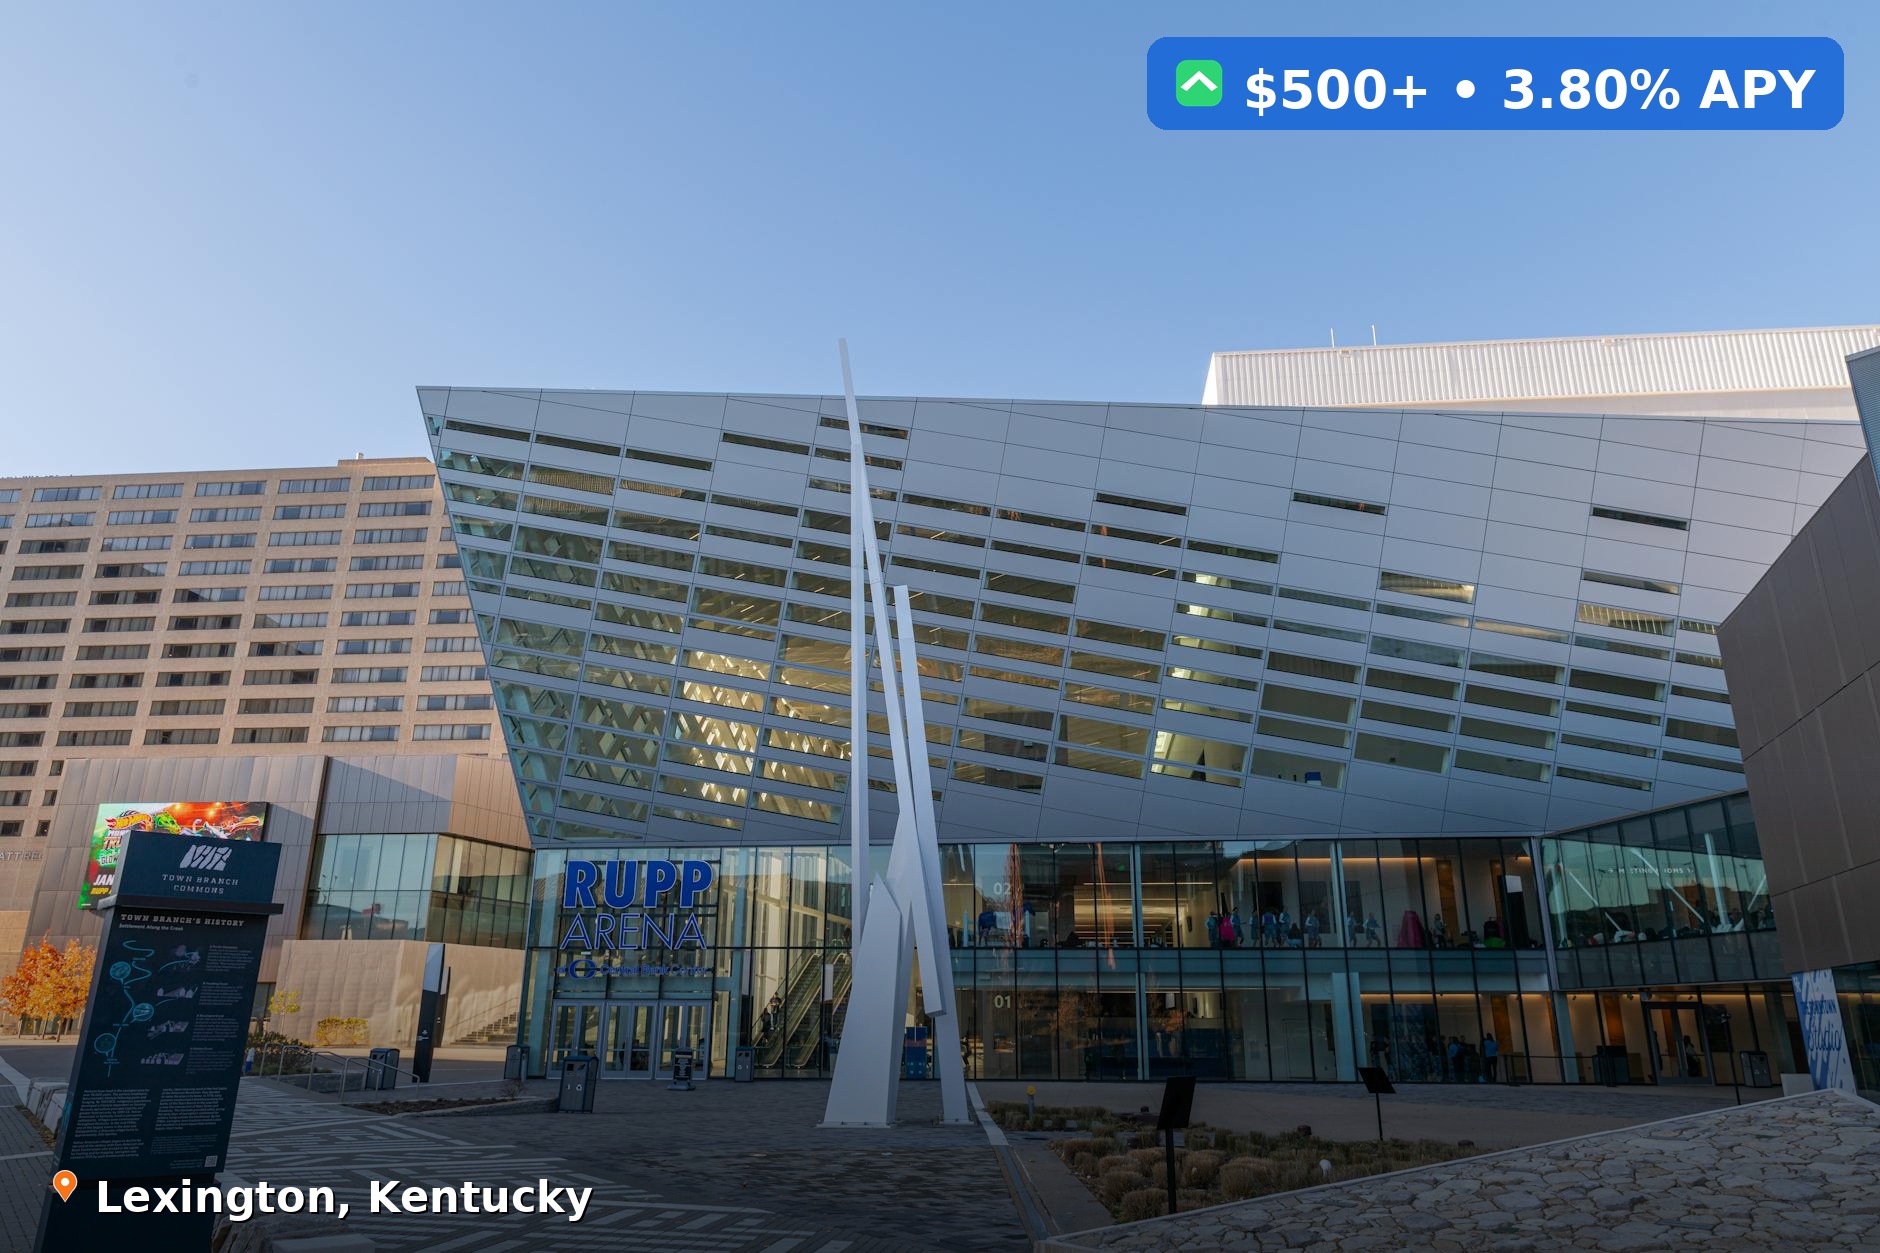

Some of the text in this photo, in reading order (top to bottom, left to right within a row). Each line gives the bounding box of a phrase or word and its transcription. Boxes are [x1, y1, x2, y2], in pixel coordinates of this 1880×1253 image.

[162, 873, 239, 886] TOWN BRANCH
[563, 859, 714, 909] RUPP
[173, 885, 225, 895] COMMONS
[993, 882, 1011, 895] 02
[120, 913, 245, 928] TOWN BRANCH'S HISTORY
[560, 912, 707, 950] ARENA
[600, 964, 639, 975] Central
[641, 964, 669, 975] Bank
[670, 964, 708, 976] Center
[994, 995, 1011, 1008] 01
